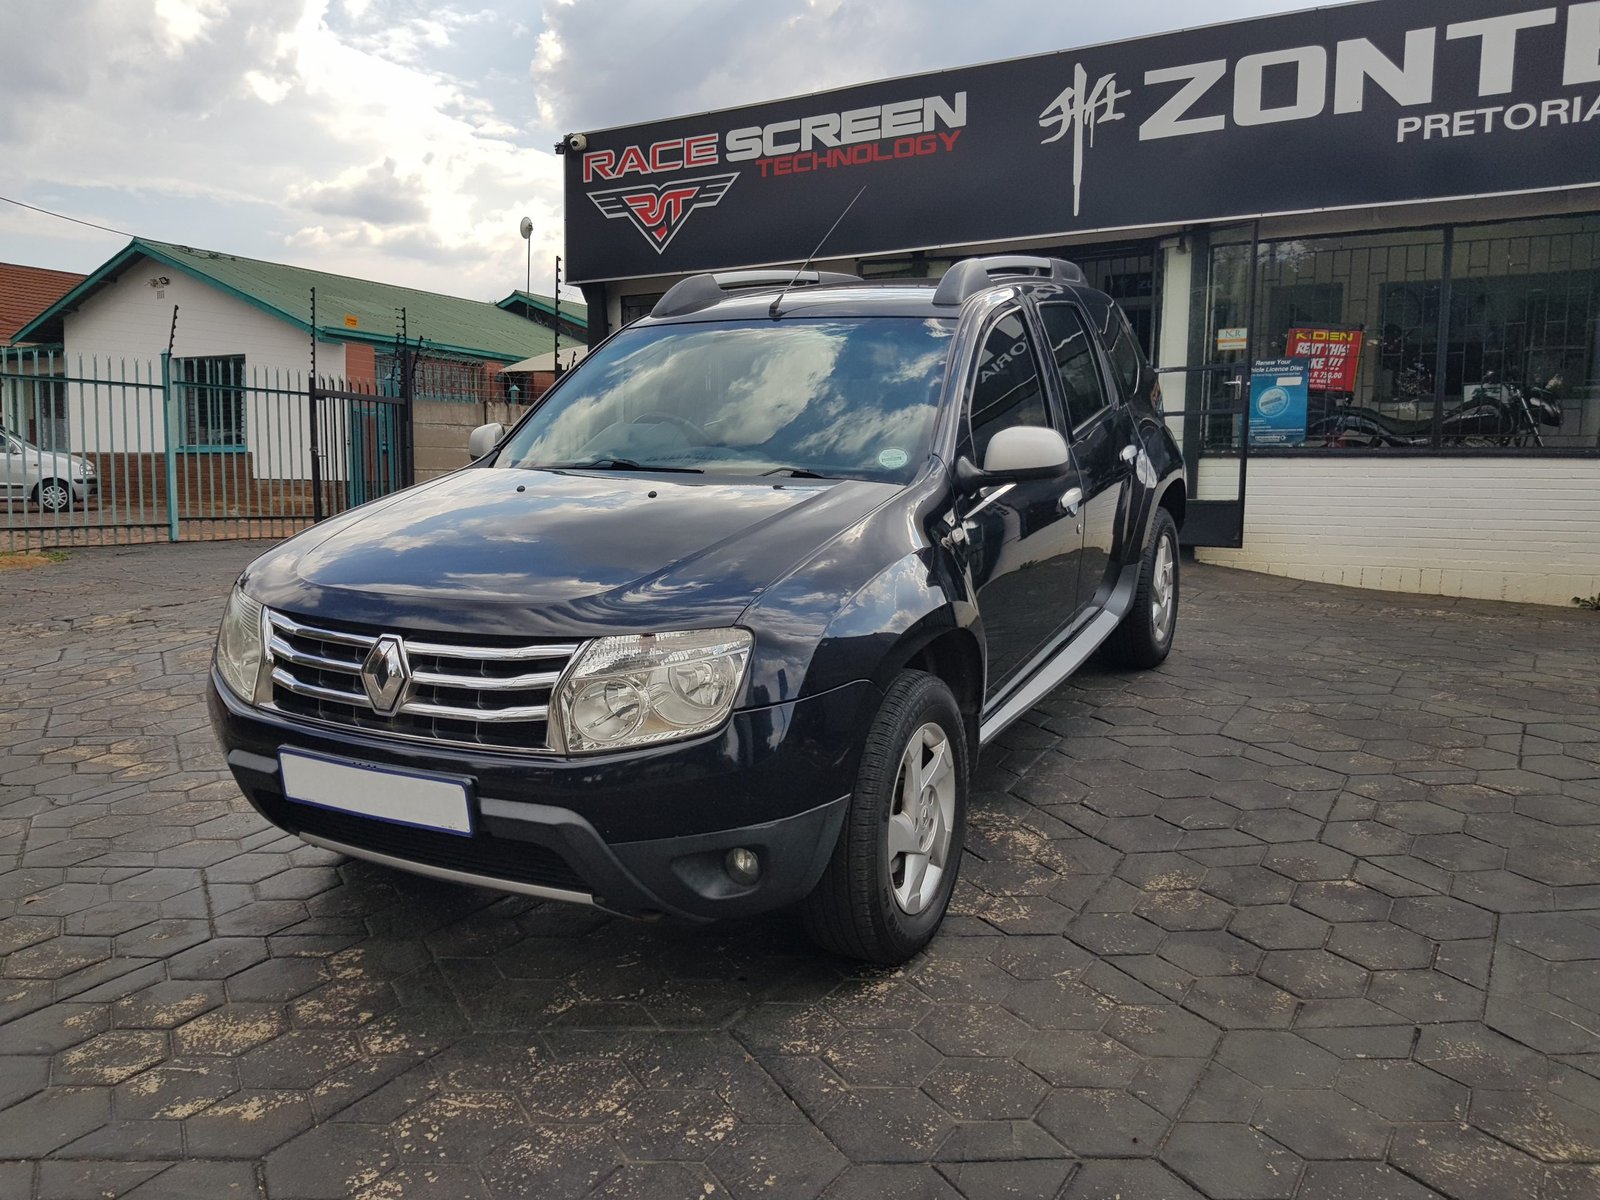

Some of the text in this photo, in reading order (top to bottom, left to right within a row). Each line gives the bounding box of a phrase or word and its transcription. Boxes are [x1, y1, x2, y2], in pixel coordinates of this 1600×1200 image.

[582, 91, 967, 183] RACE SCREEN
[756, 130, 962, 178] TECHNOLOGY
[1296, 342, 1324, 355] RENT
